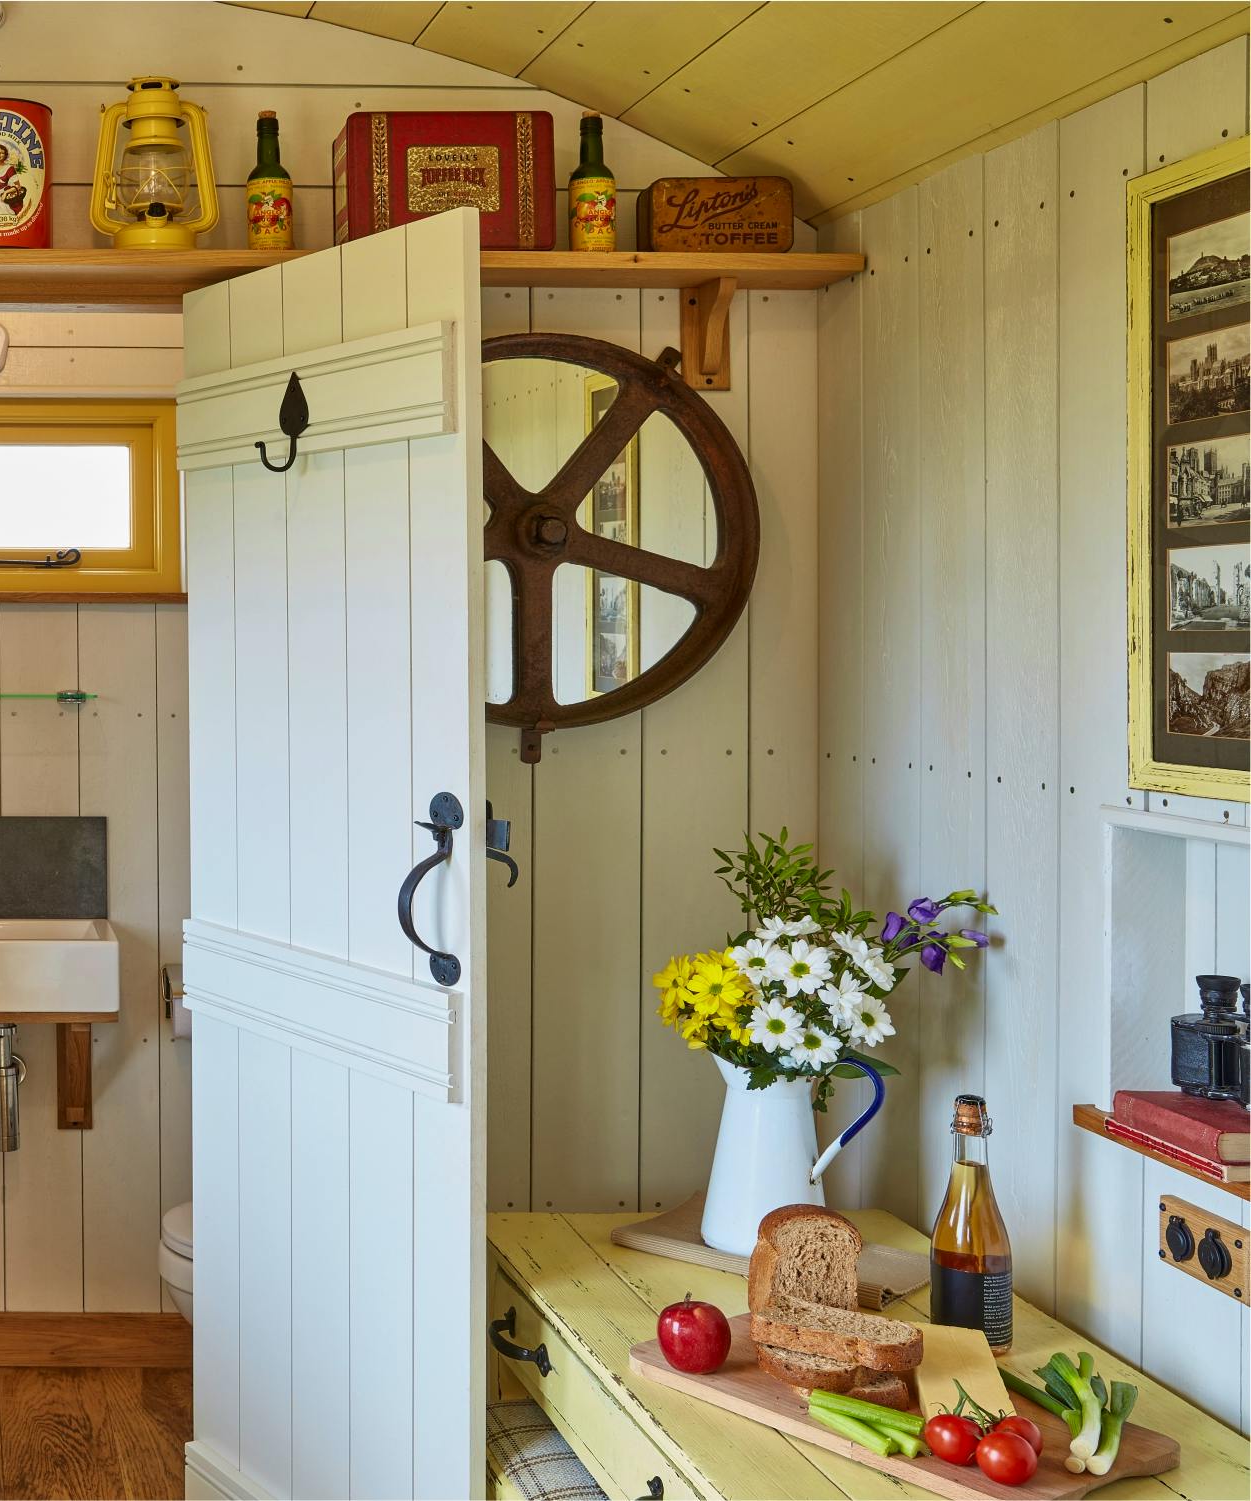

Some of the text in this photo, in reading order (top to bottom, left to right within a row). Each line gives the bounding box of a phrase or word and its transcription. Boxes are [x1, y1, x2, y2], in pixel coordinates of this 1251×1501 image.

[7, 133, 22, 145] MILK
[420, 167, 487, 189] TOFFEE REX
[707, 222, 778, 230] BUTTER CREAM
[3, 228, 20, 237] made
[700, 232, 779, 245] TOFFEE
